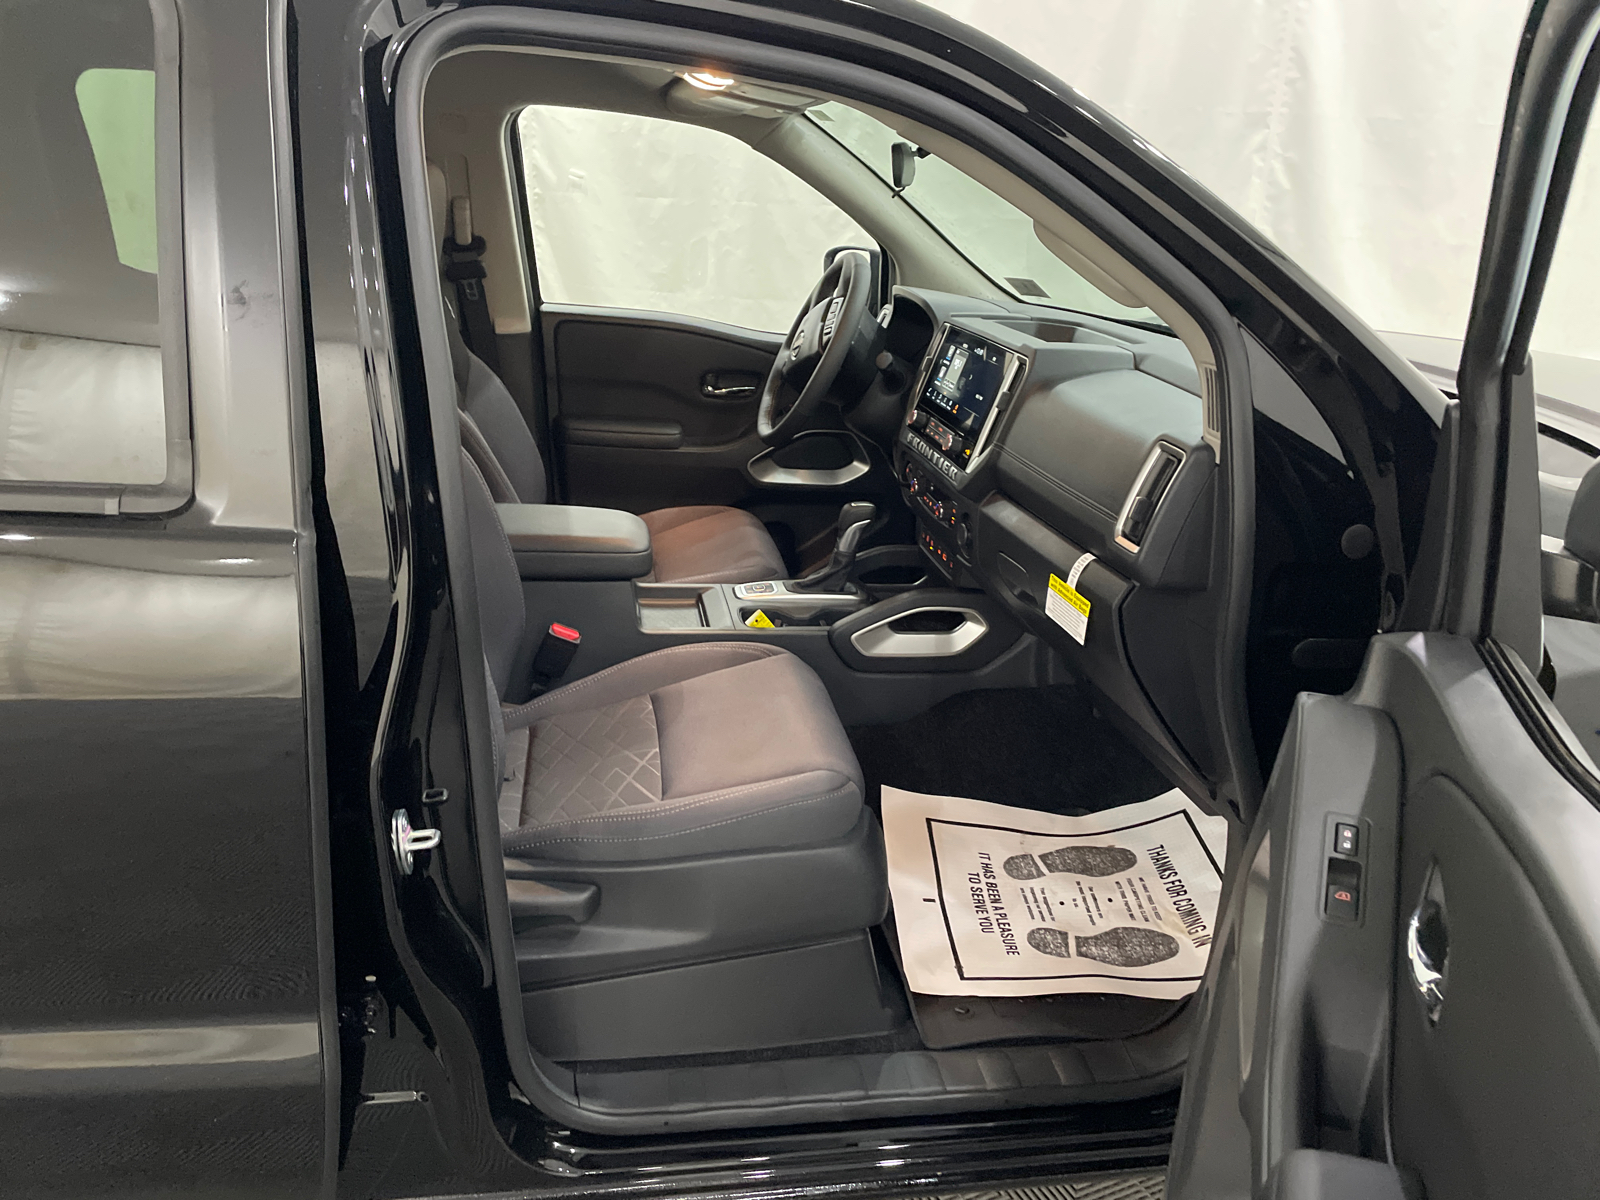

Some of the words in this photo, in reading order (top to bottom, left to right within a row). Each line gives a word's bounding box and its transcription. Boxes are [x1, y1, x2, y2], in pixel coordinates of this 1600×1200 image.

[907, 432, 958, 480] FRONTIER
[978, 852, 991, 861] IT
[1146, 844, 1178, 880] THANKS
[968, 872, 982, 884] TO
[980, 862, 996, 880] HAS
[985, 882, 1002, 904] BEEN
[1163, 879, 1188, 899] FOR
[970, 886, 989, 915] SERVE
[978, 916, 995, 934] YOU
[1173, 898, 1207, 936] COMING
[994, 912, 1020, 956] PLEASURE
[1191, 934, 1213, 949] IN
